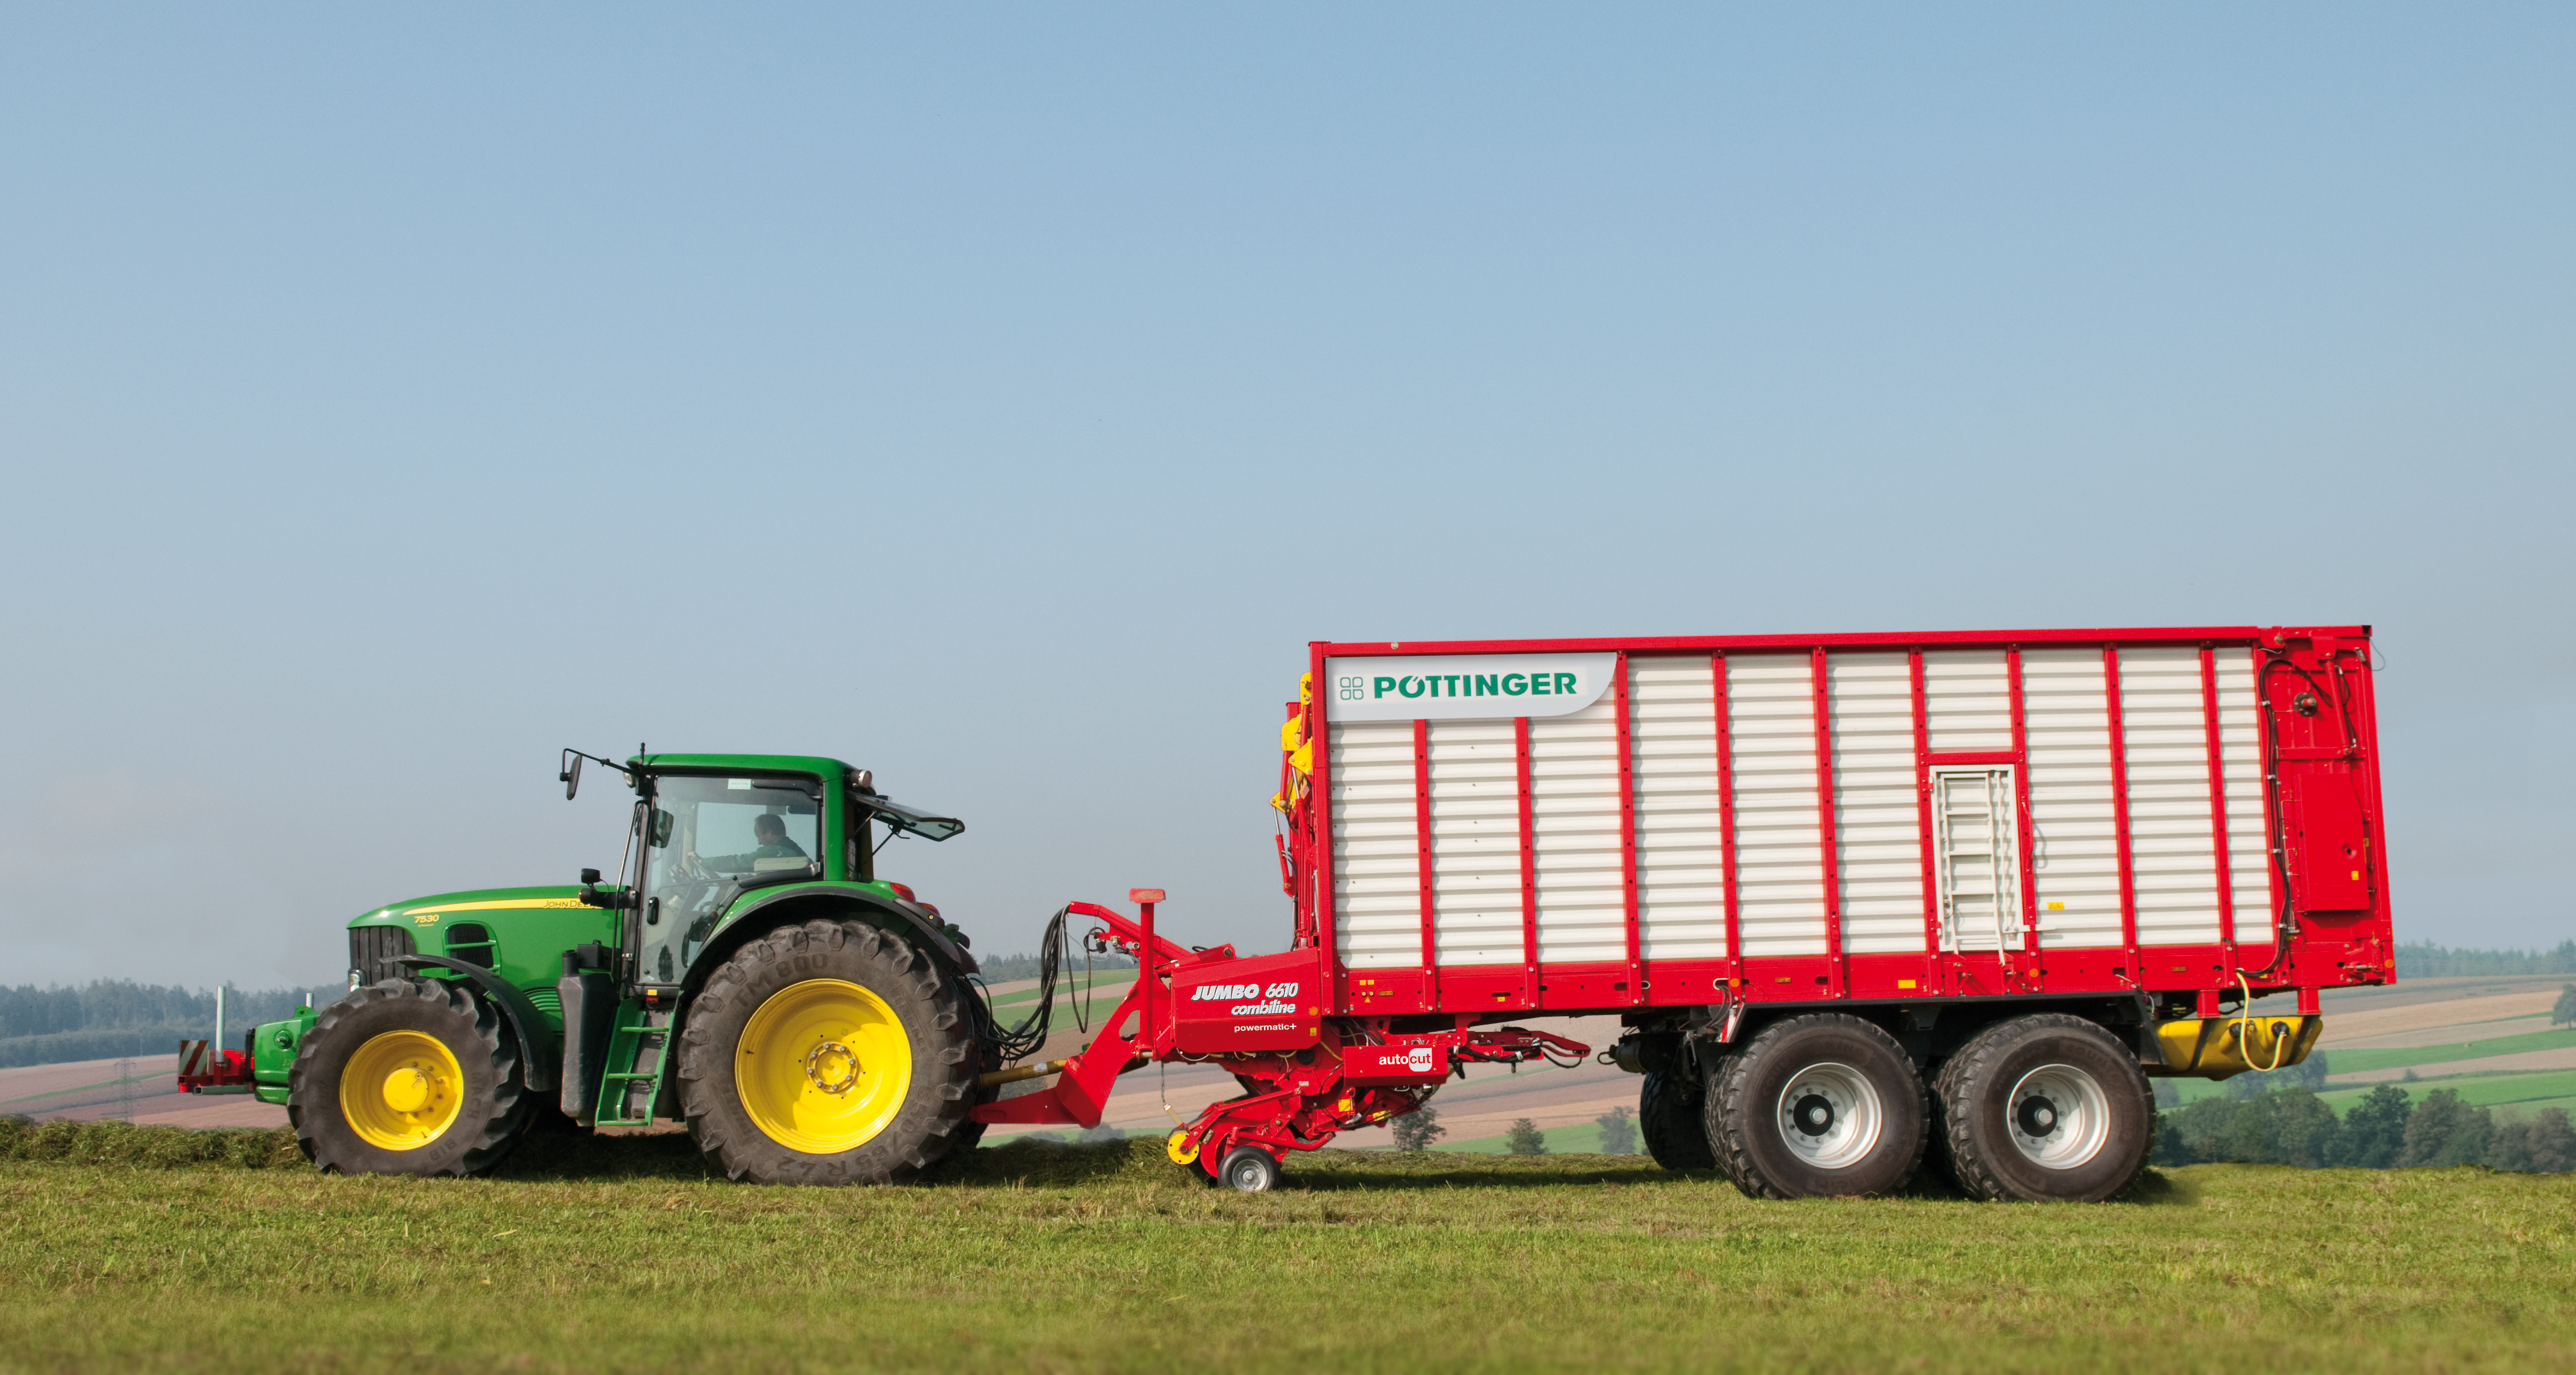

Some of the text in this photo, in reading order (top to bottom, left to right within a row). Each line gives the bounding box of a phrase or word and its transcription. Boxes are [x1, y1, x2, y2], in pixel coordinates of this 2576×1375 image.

[1373, 672, 1577, 698] PÖTTINGER
[415, 914, 440, 923] 7530
[730, 953, 828, 1008] TM 800
[1191, 983, 1299, 1001] JUMBO 6610
[1231, 999, 1296, 1016] combiline
[1234, 1023, 1297, 1033] powermatic+
[776, 1085, 932, 1177] 650/65 R 42
[428, 1138, 457, 1161] BIB
